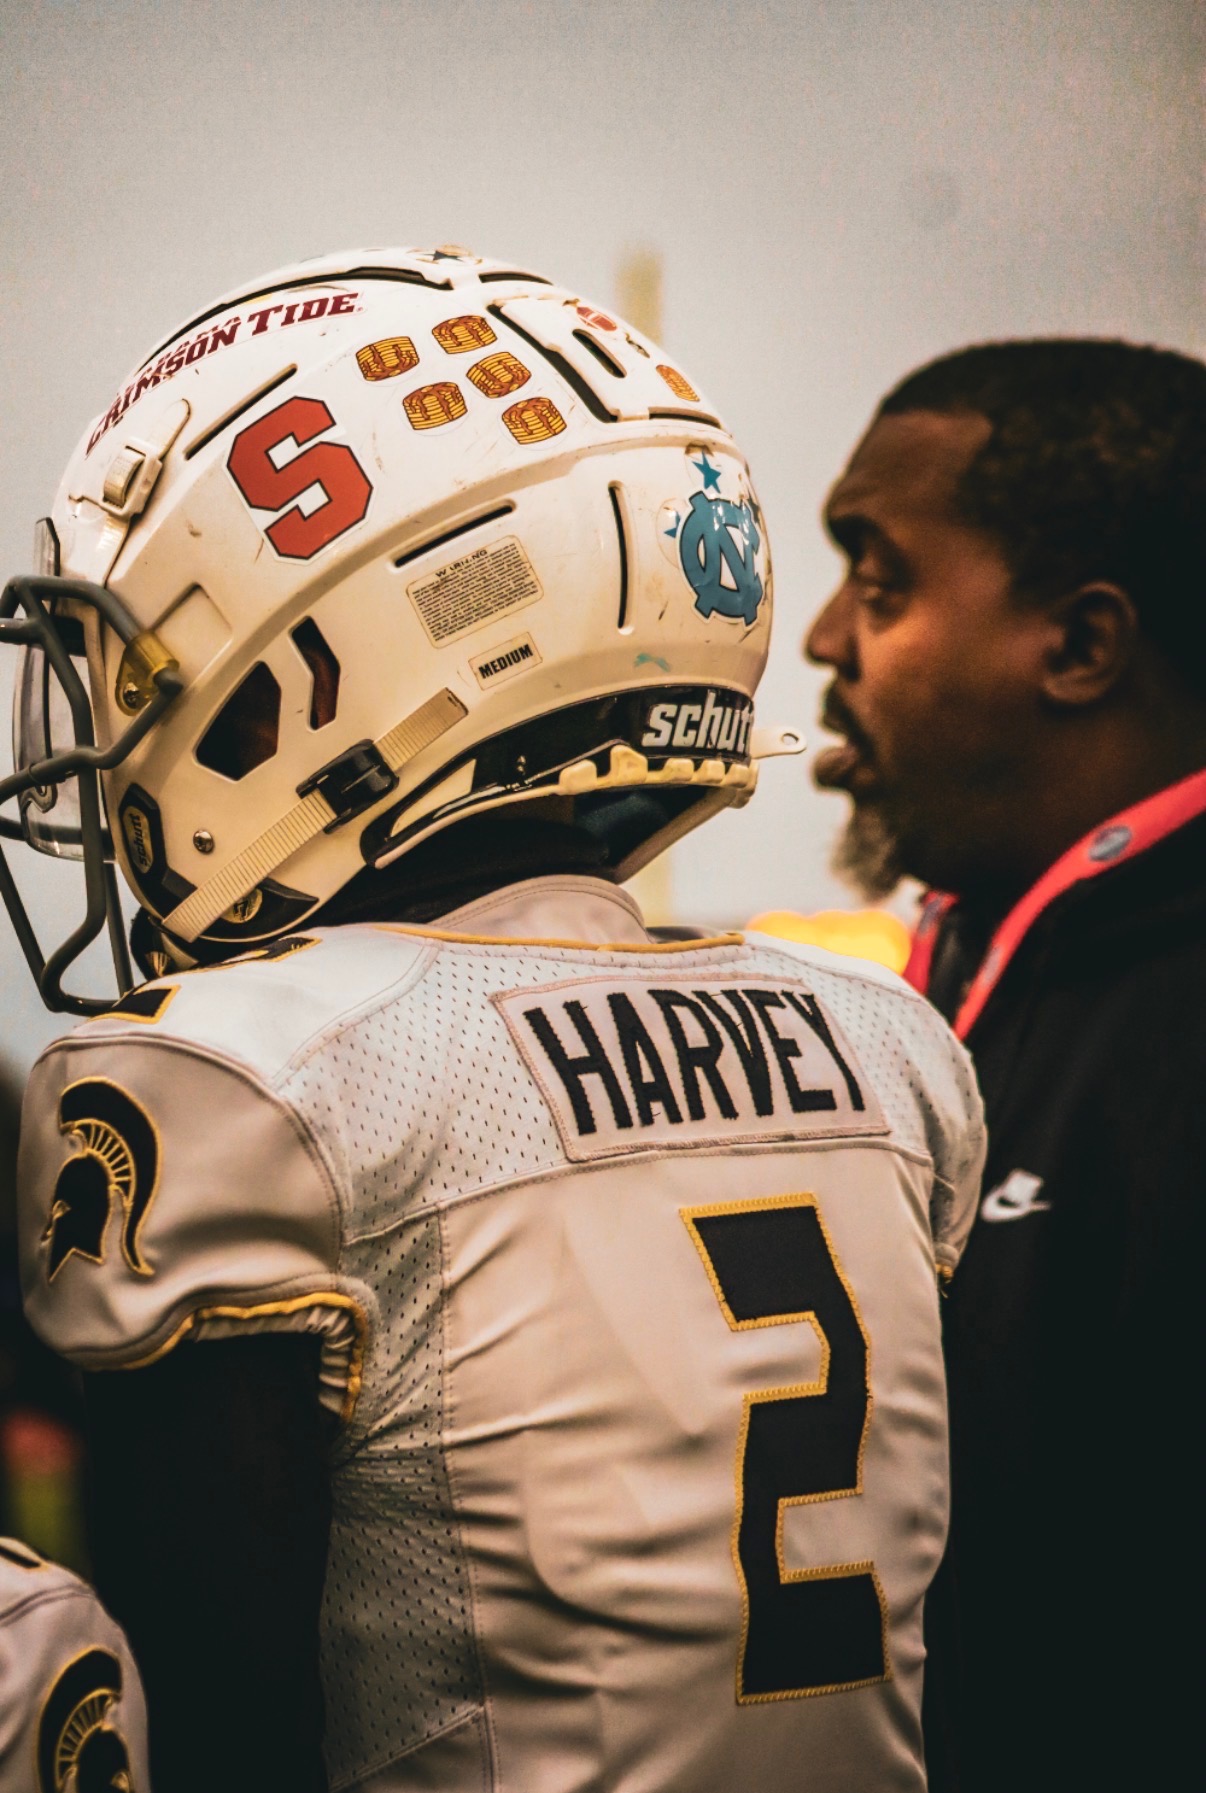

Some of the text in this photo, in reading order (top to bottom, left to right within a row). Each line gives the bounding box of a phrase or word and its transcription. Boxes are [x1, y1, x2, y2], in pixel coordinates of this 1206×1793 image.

[86, 321, 242, 458] CRIMSON
[247, 293, 359, 336] TIDE
[227, 396, 373, 560] S
[435, 549, 488, 578] WRNNG
[478, 644, 534, 679] MEDIUM
[641, 689, 754, 753] schut
[523, 989, 865, 1135] HARVEY
[679, 1193, 893, 1705] 2
